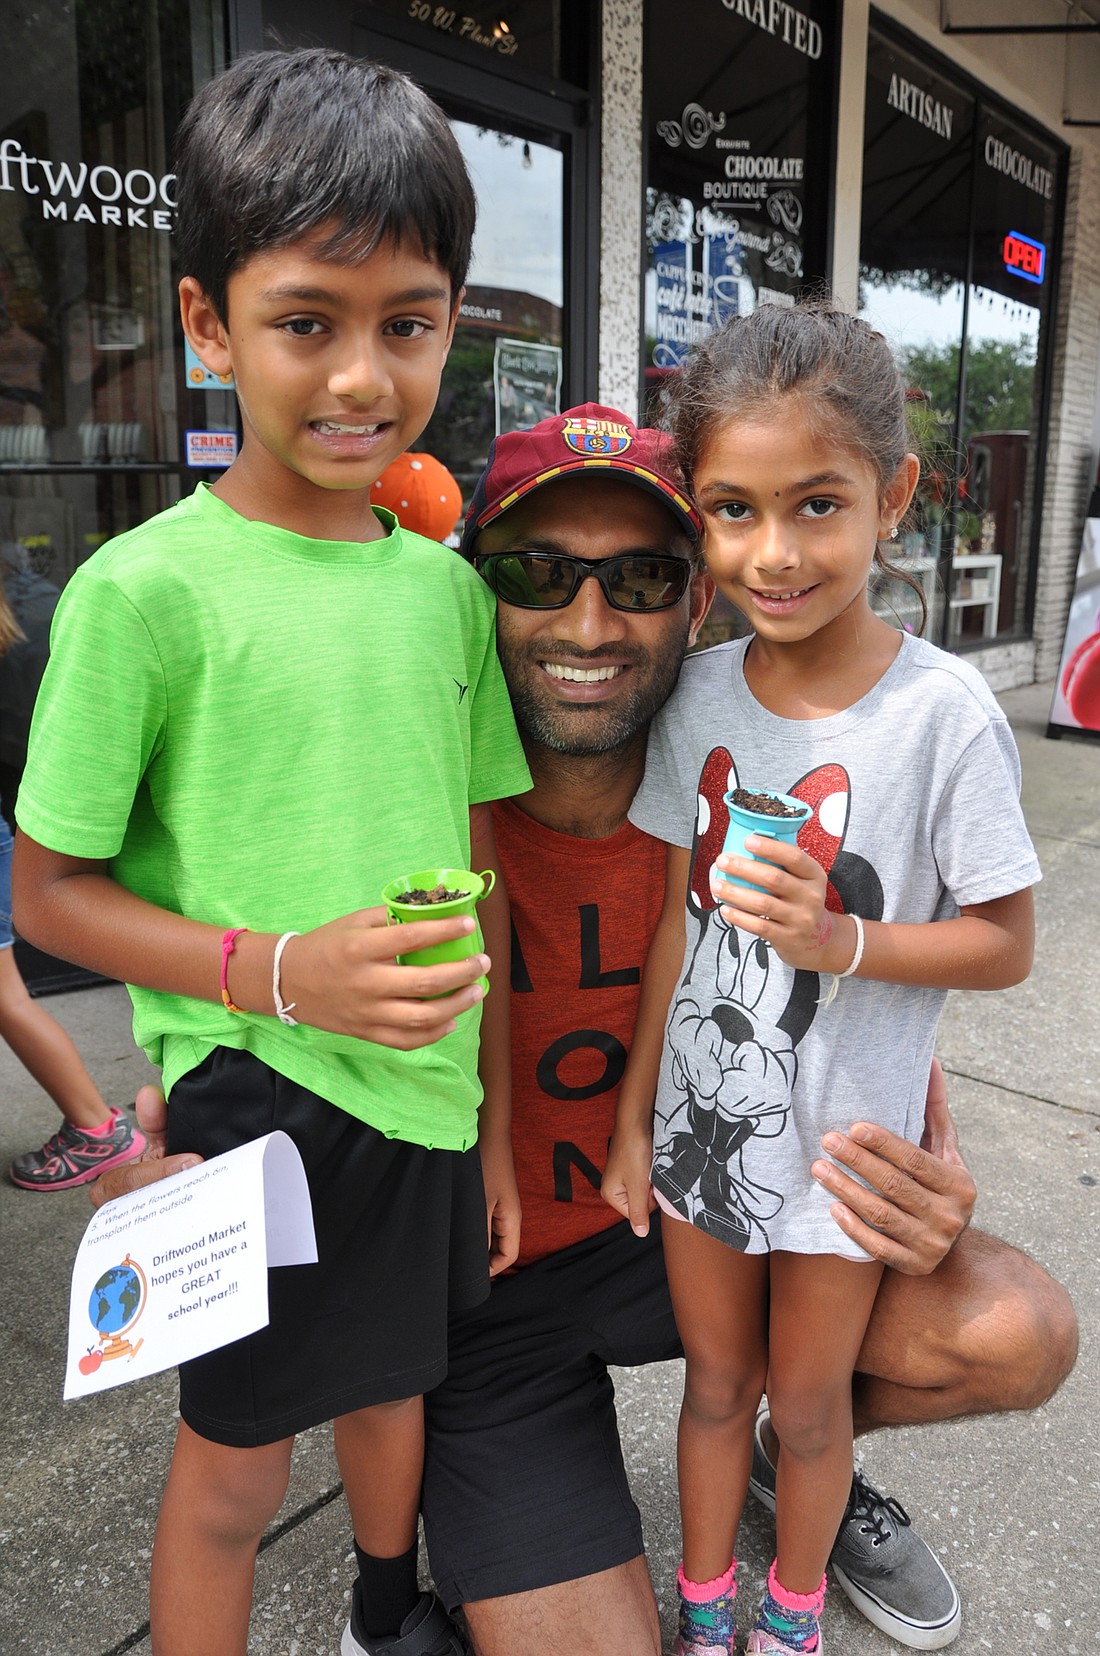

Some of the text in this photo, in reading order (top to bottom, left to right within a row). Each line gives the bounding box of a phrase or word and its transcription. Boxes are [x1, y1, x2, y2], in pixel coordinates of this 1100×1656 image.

[408, 0, 431, 21] 50
[432, 6, 456, 32] W.
[722, 0, 823, 59] AFTED
[887, 73, 953, 140] ARTISAN
[725, 155, 804, 180] CHOCOLATE
[985, 135, 1053, 199] CHOCOLATE
[703, 182, 769, 200] BOUTIQUE
[42, 199, 179, 231] MARKE
[1003, 235, 1043, 276] OPEN
[191, 436, 233, 447] CRIME
[105, 1210, 129, 1225] When
[131, 1201, 146, 1213] the
[148, 1187, 181, 1206] flowers
[183, 1172, 210, 1190] reach
[87, 1193, 193, 1247] transplant them outside
[151, 1241, 248, 1287] hopes you have a
[152, 1220, 247, 1267] Driftwood Market
[167, 1281, 239, 1320] school year!!!
[181, 1268, 221, 1294] GREAT
